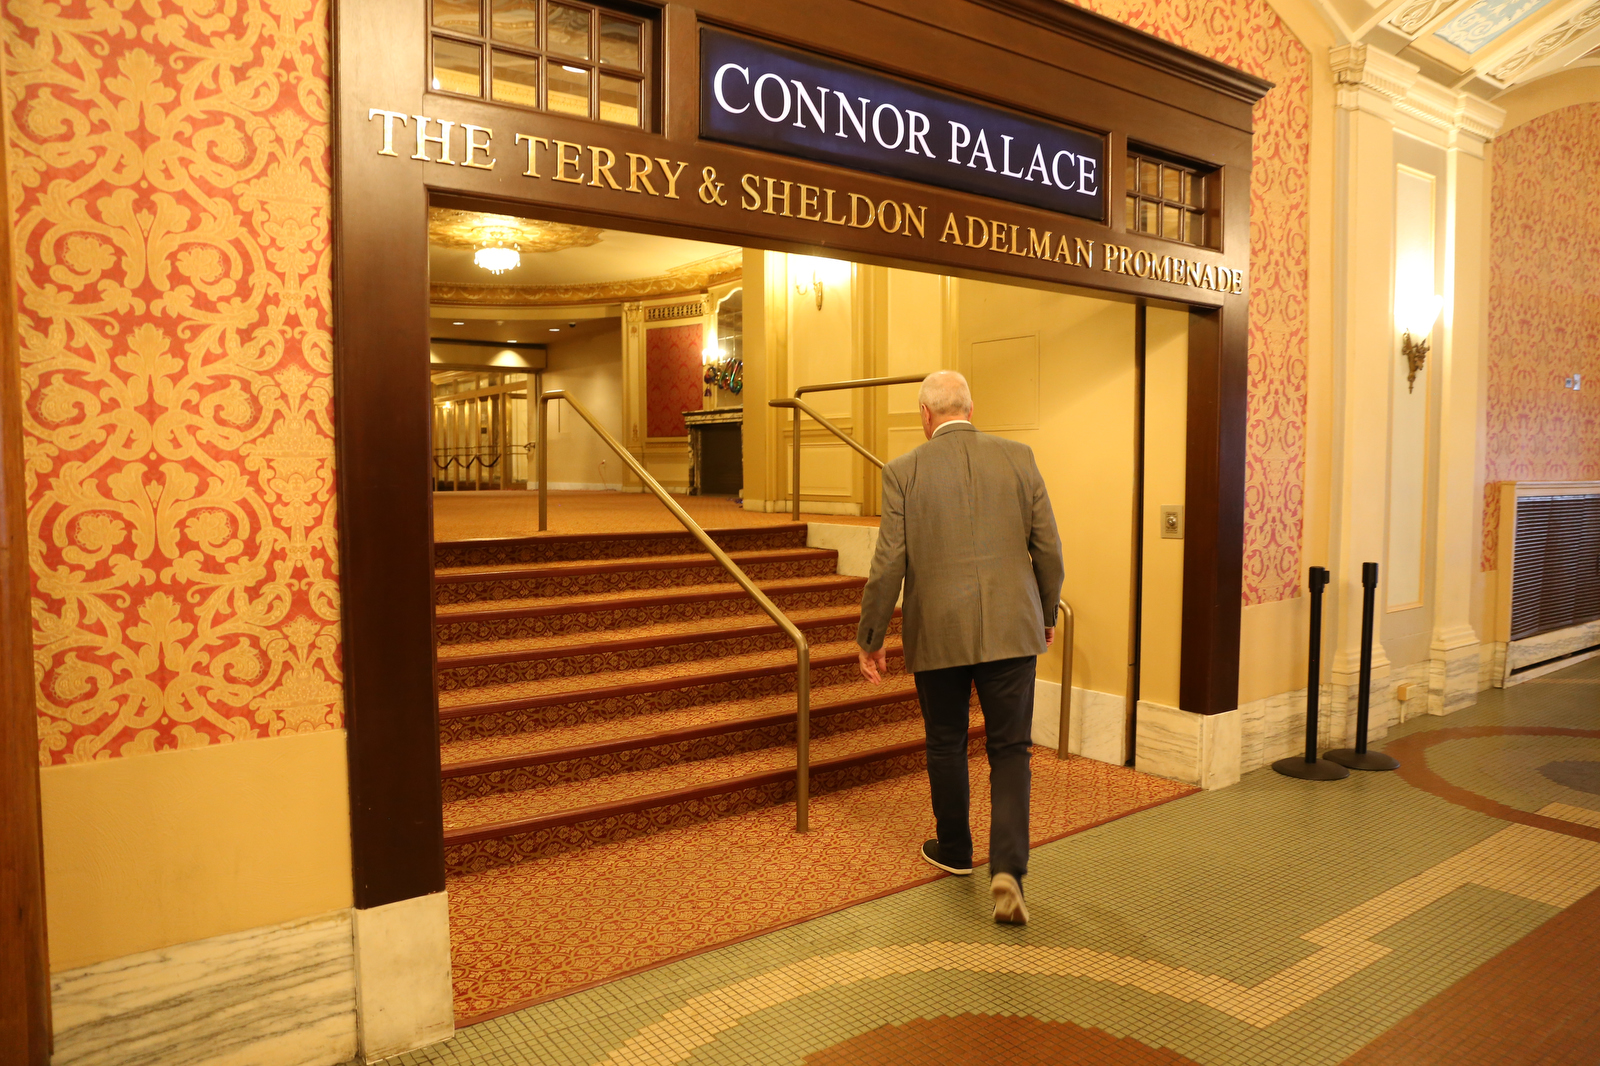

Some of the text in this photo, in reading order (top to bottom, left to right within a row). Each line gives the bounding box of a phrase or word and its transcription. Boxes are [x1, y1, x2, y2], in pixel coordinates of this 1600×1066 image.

[368, 108, 1244, 295] THE TERRY & SHELDON ADELMAN PROMENADE
[713, 63, 1098, 196] CONNOR PALACE
